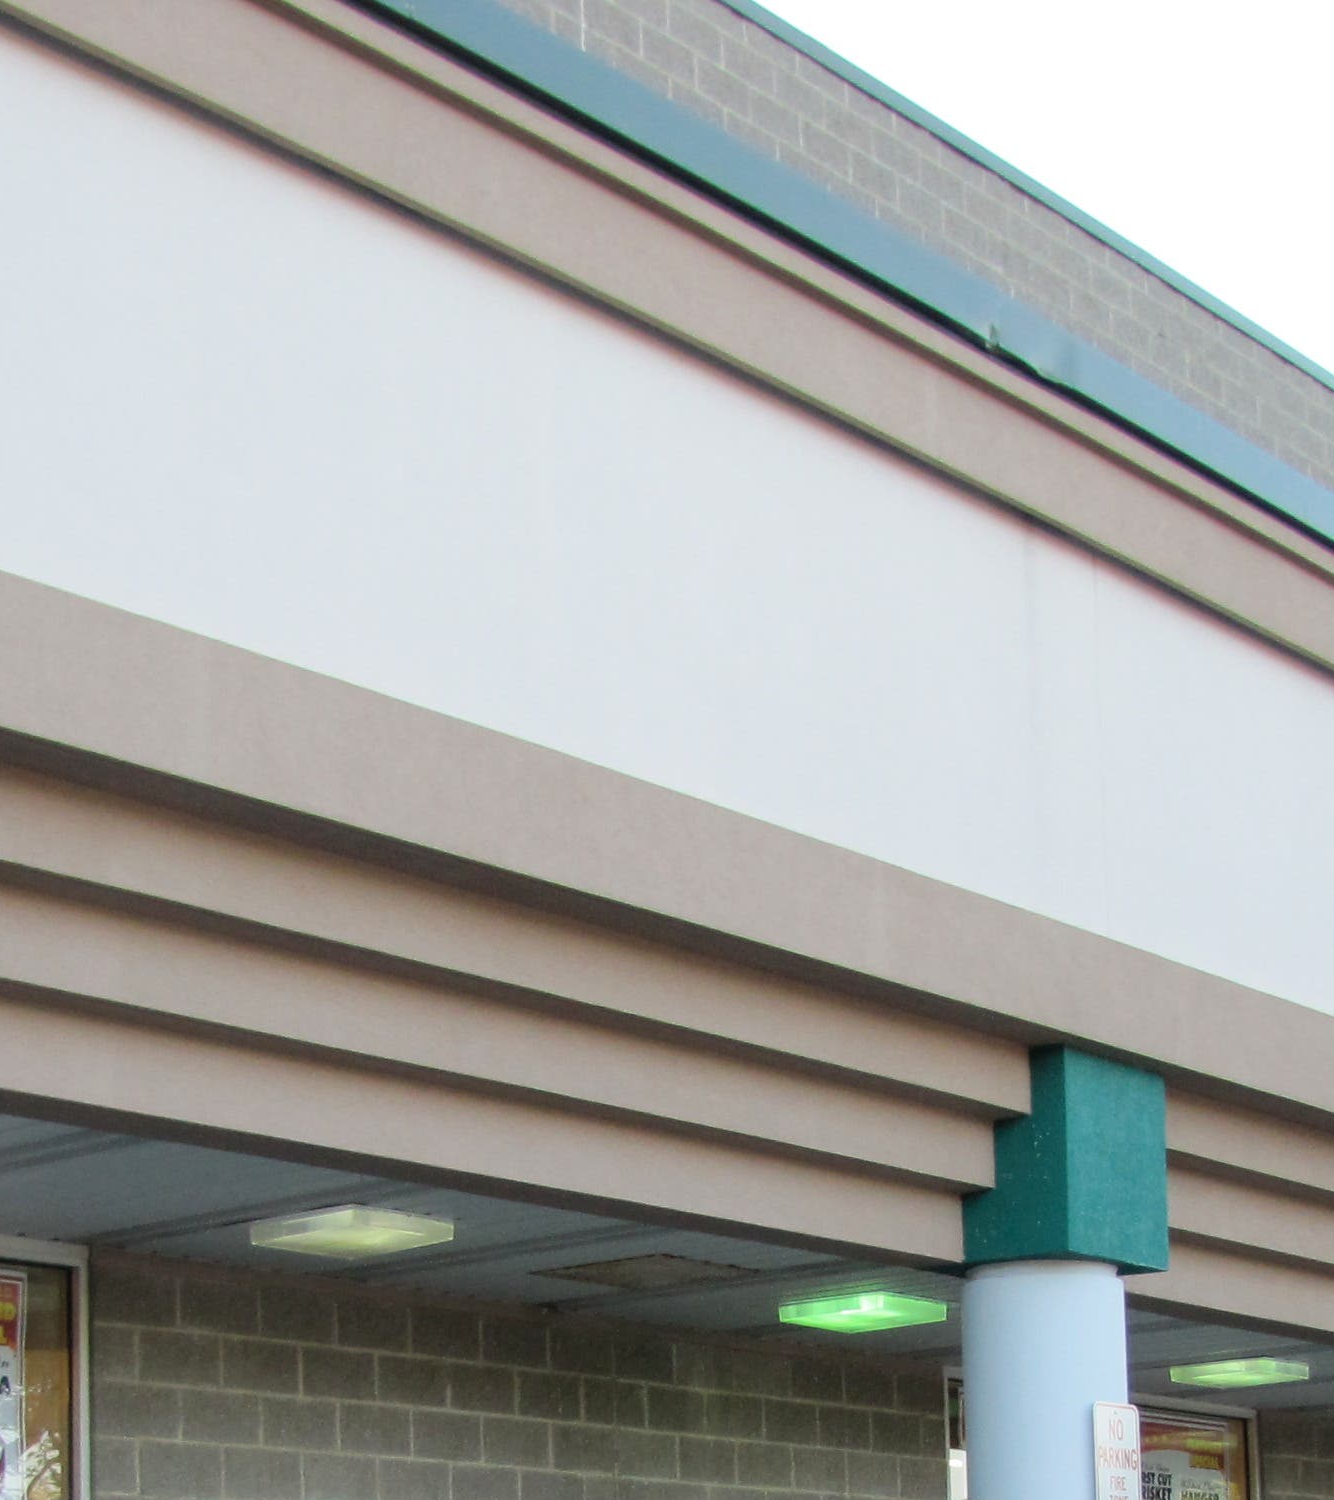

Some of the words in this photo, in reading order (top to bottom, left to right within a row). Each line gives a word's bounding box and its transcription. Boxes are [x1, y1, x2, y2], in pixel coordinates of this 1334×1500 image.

[1109, 1419, 1124, 1441] NO
[1098, 1447, 1138, 1471] PARKING
[1110, 1475, 1127, 1491] FIRE
[1157, 1473, 1173, 1487] CUT
